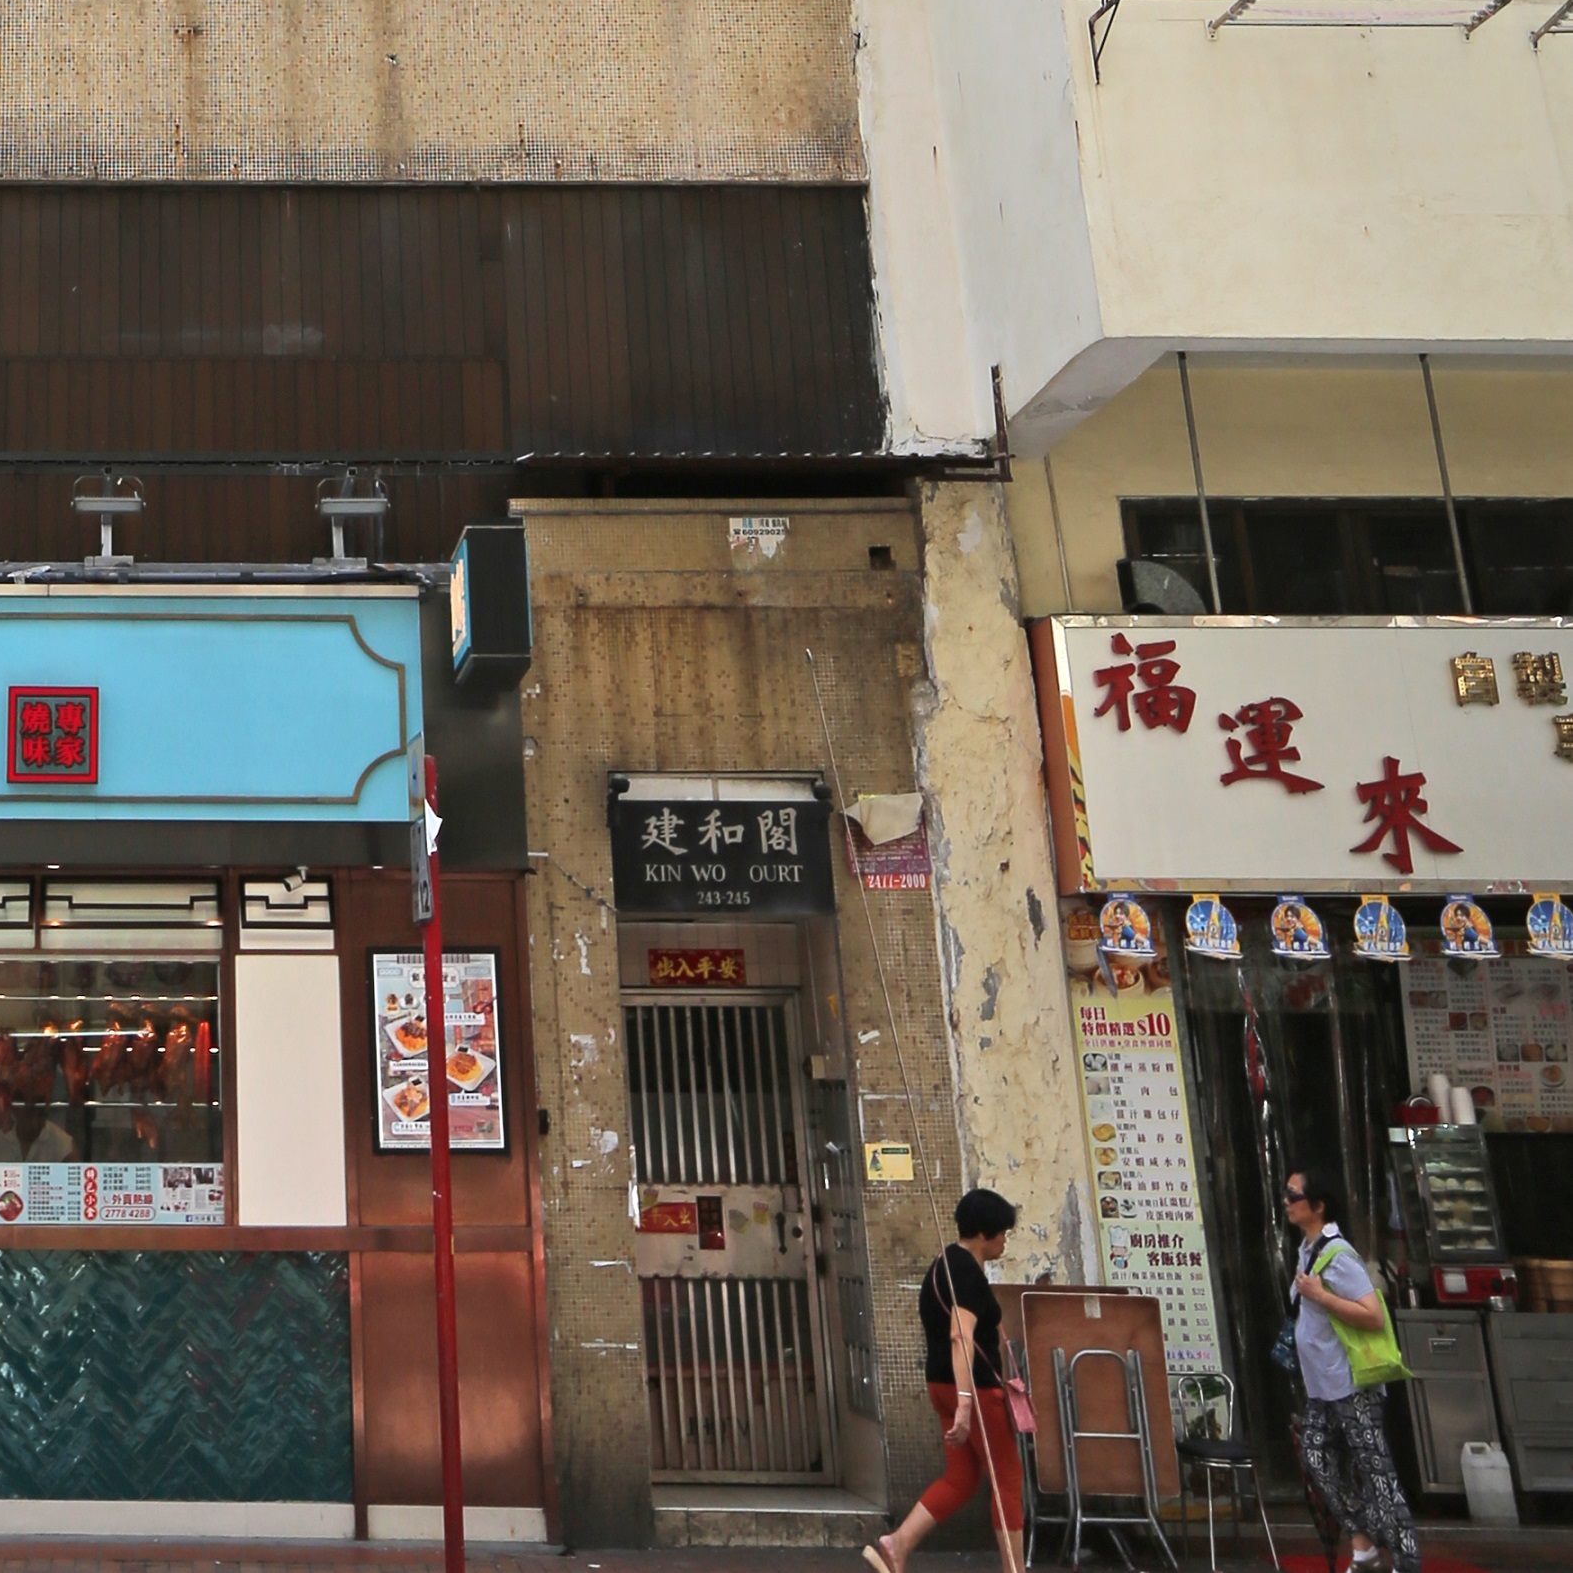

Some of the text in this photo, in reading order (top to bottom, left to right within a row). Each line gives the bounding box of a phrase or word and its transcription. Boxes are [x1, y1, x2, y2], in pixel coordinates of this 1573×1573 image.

[1450, 651, 1569, 706] 自製
[1093, 631, 1464, 875] 福運來
[641, 806, 798, 856] 建和閣
[645, 864, 682, 883] KIN
[690, 864, 726, 883] WO
[697, 891, 751, 905] 243-245
[656, 956, 739, 980] 出入平安
[1080, 1006, 1106, 1021] 每日
[1137, 1012, 1171, 1037] $10
[1147, 1252, 1202, 1267] 客飯套餐
